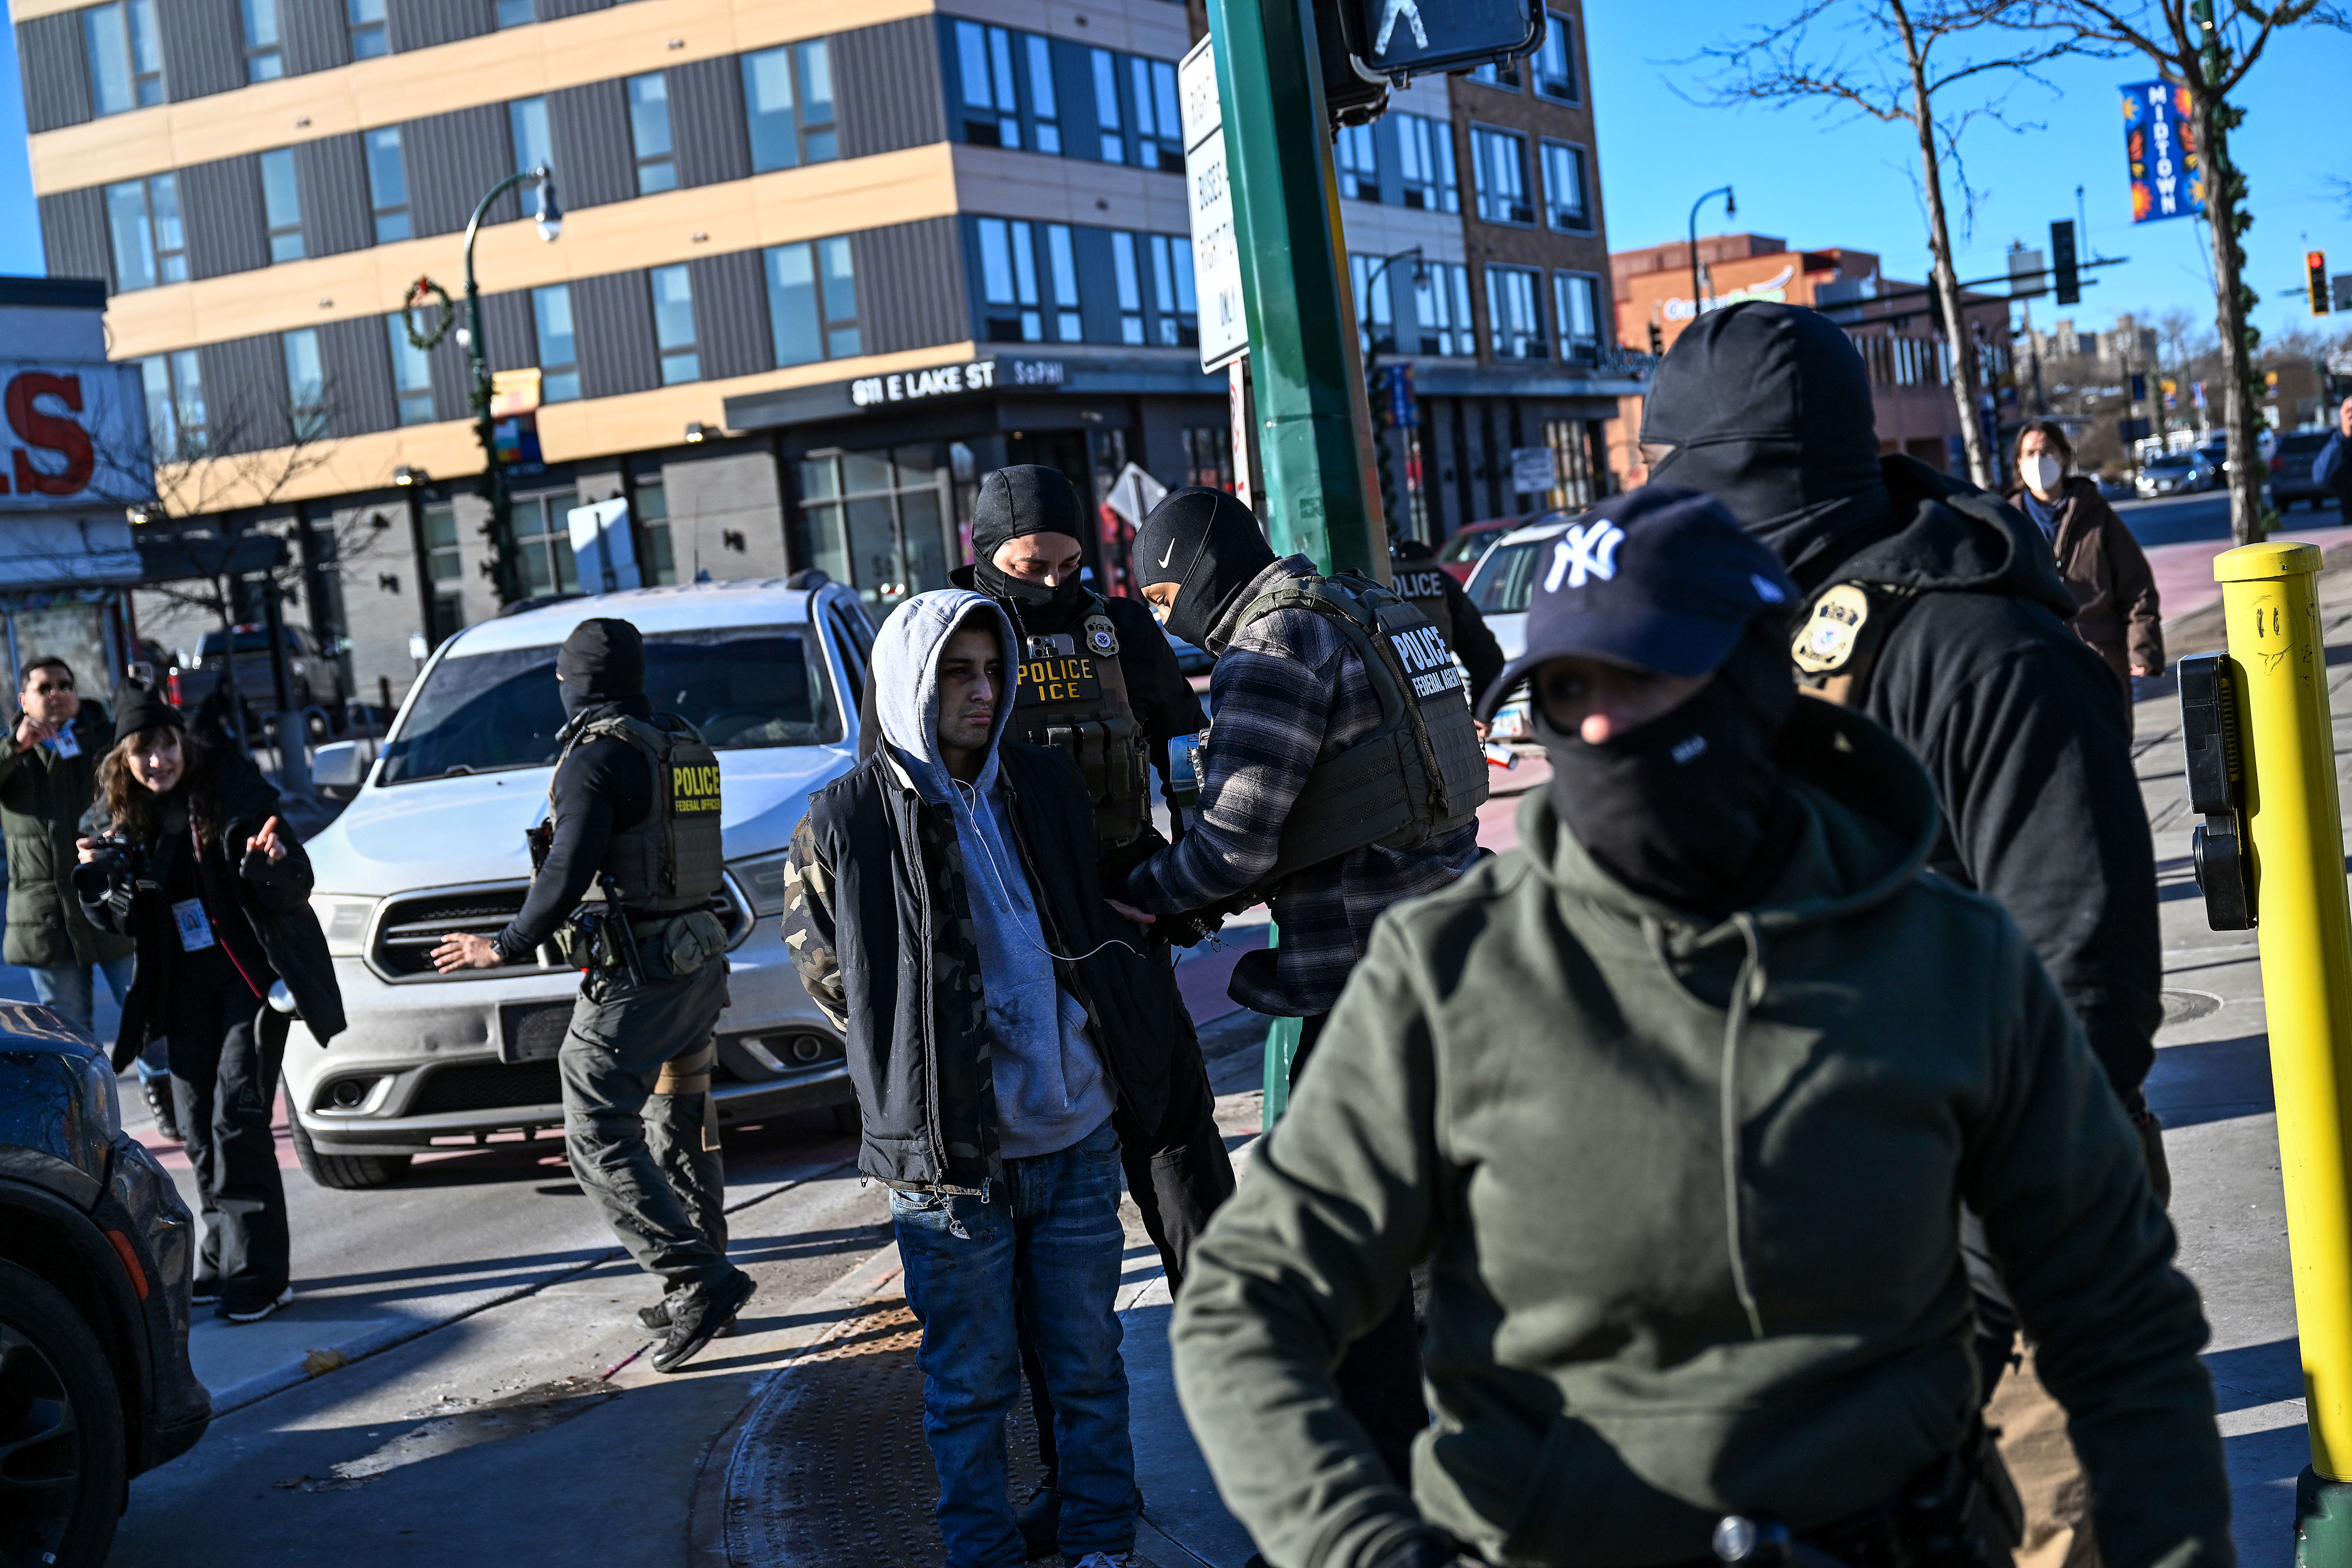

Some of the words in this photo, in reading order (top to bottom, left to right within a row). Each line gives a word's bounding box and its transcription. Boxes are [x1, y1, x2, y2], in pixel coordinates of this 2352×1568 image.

[2148, 84, 2176, 215] MIDTOWN
[1198, 160, 1222, 211] BUSES
[886, 374, 904, 402] E
[905, 366, 962, 399] LAKE
[965, 361, 995, 390] ST
[0, 371, 94, 495] S
[1392, 572, 1442, 597] OLICE
[1390, 626, 1452, 673] POLICE
[1017, 659, 1094, 685] POLICE
[1411, 672, 1446, 698] FEDERAL
[1441, 667, 1462, 690] AGENT
[1038, 682, 1080, 701] ICE
[673, 766, 720, 797] POLICE
[675, 799, 700, 813] FEDERAL
